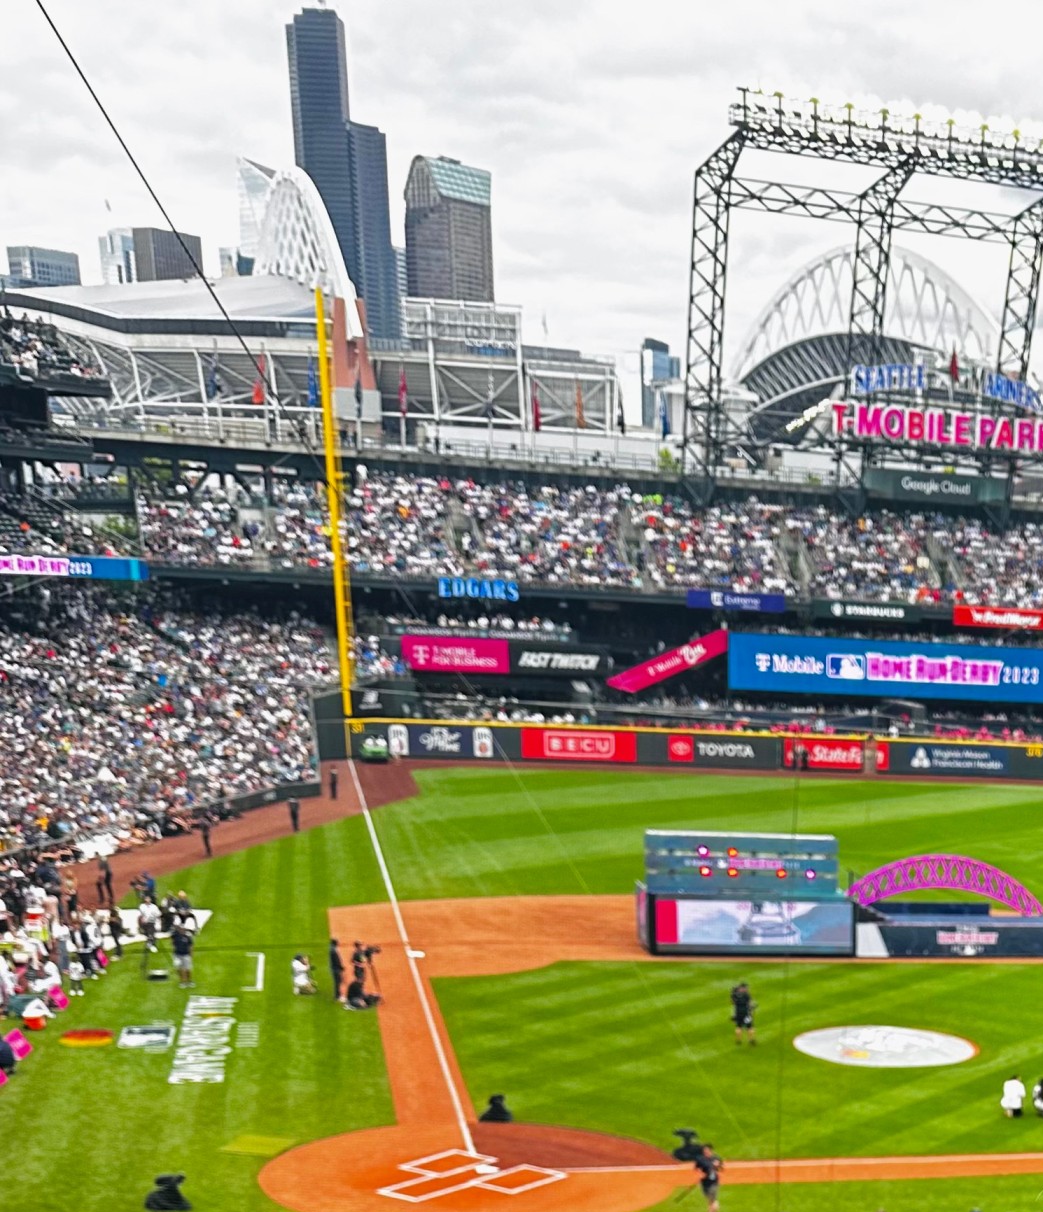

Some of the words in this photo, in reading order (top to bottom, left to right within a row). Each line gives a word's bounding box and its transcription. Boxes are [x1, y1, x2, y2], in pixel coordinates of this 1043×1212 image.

[852, 364, 925, 393] SEATTLE
[832, 403, 971, 446] T-MOBILE
[901, 476, 940, 493] Google
[941, 480, 971, 495] Cloud
[845, 605, 905, 619] STARBUCKS
[772, 653, 824, 674] Mobile
[865, 655, 912, 681] HOME
[915, 658, 948, 683] RUN
[950, 660, 1001, 686] DERBY
[1002, 666, 1040, 685] 2023
[550, 735, 612, 753] BECU
[697, 741, 755, 759] TOYOTA
